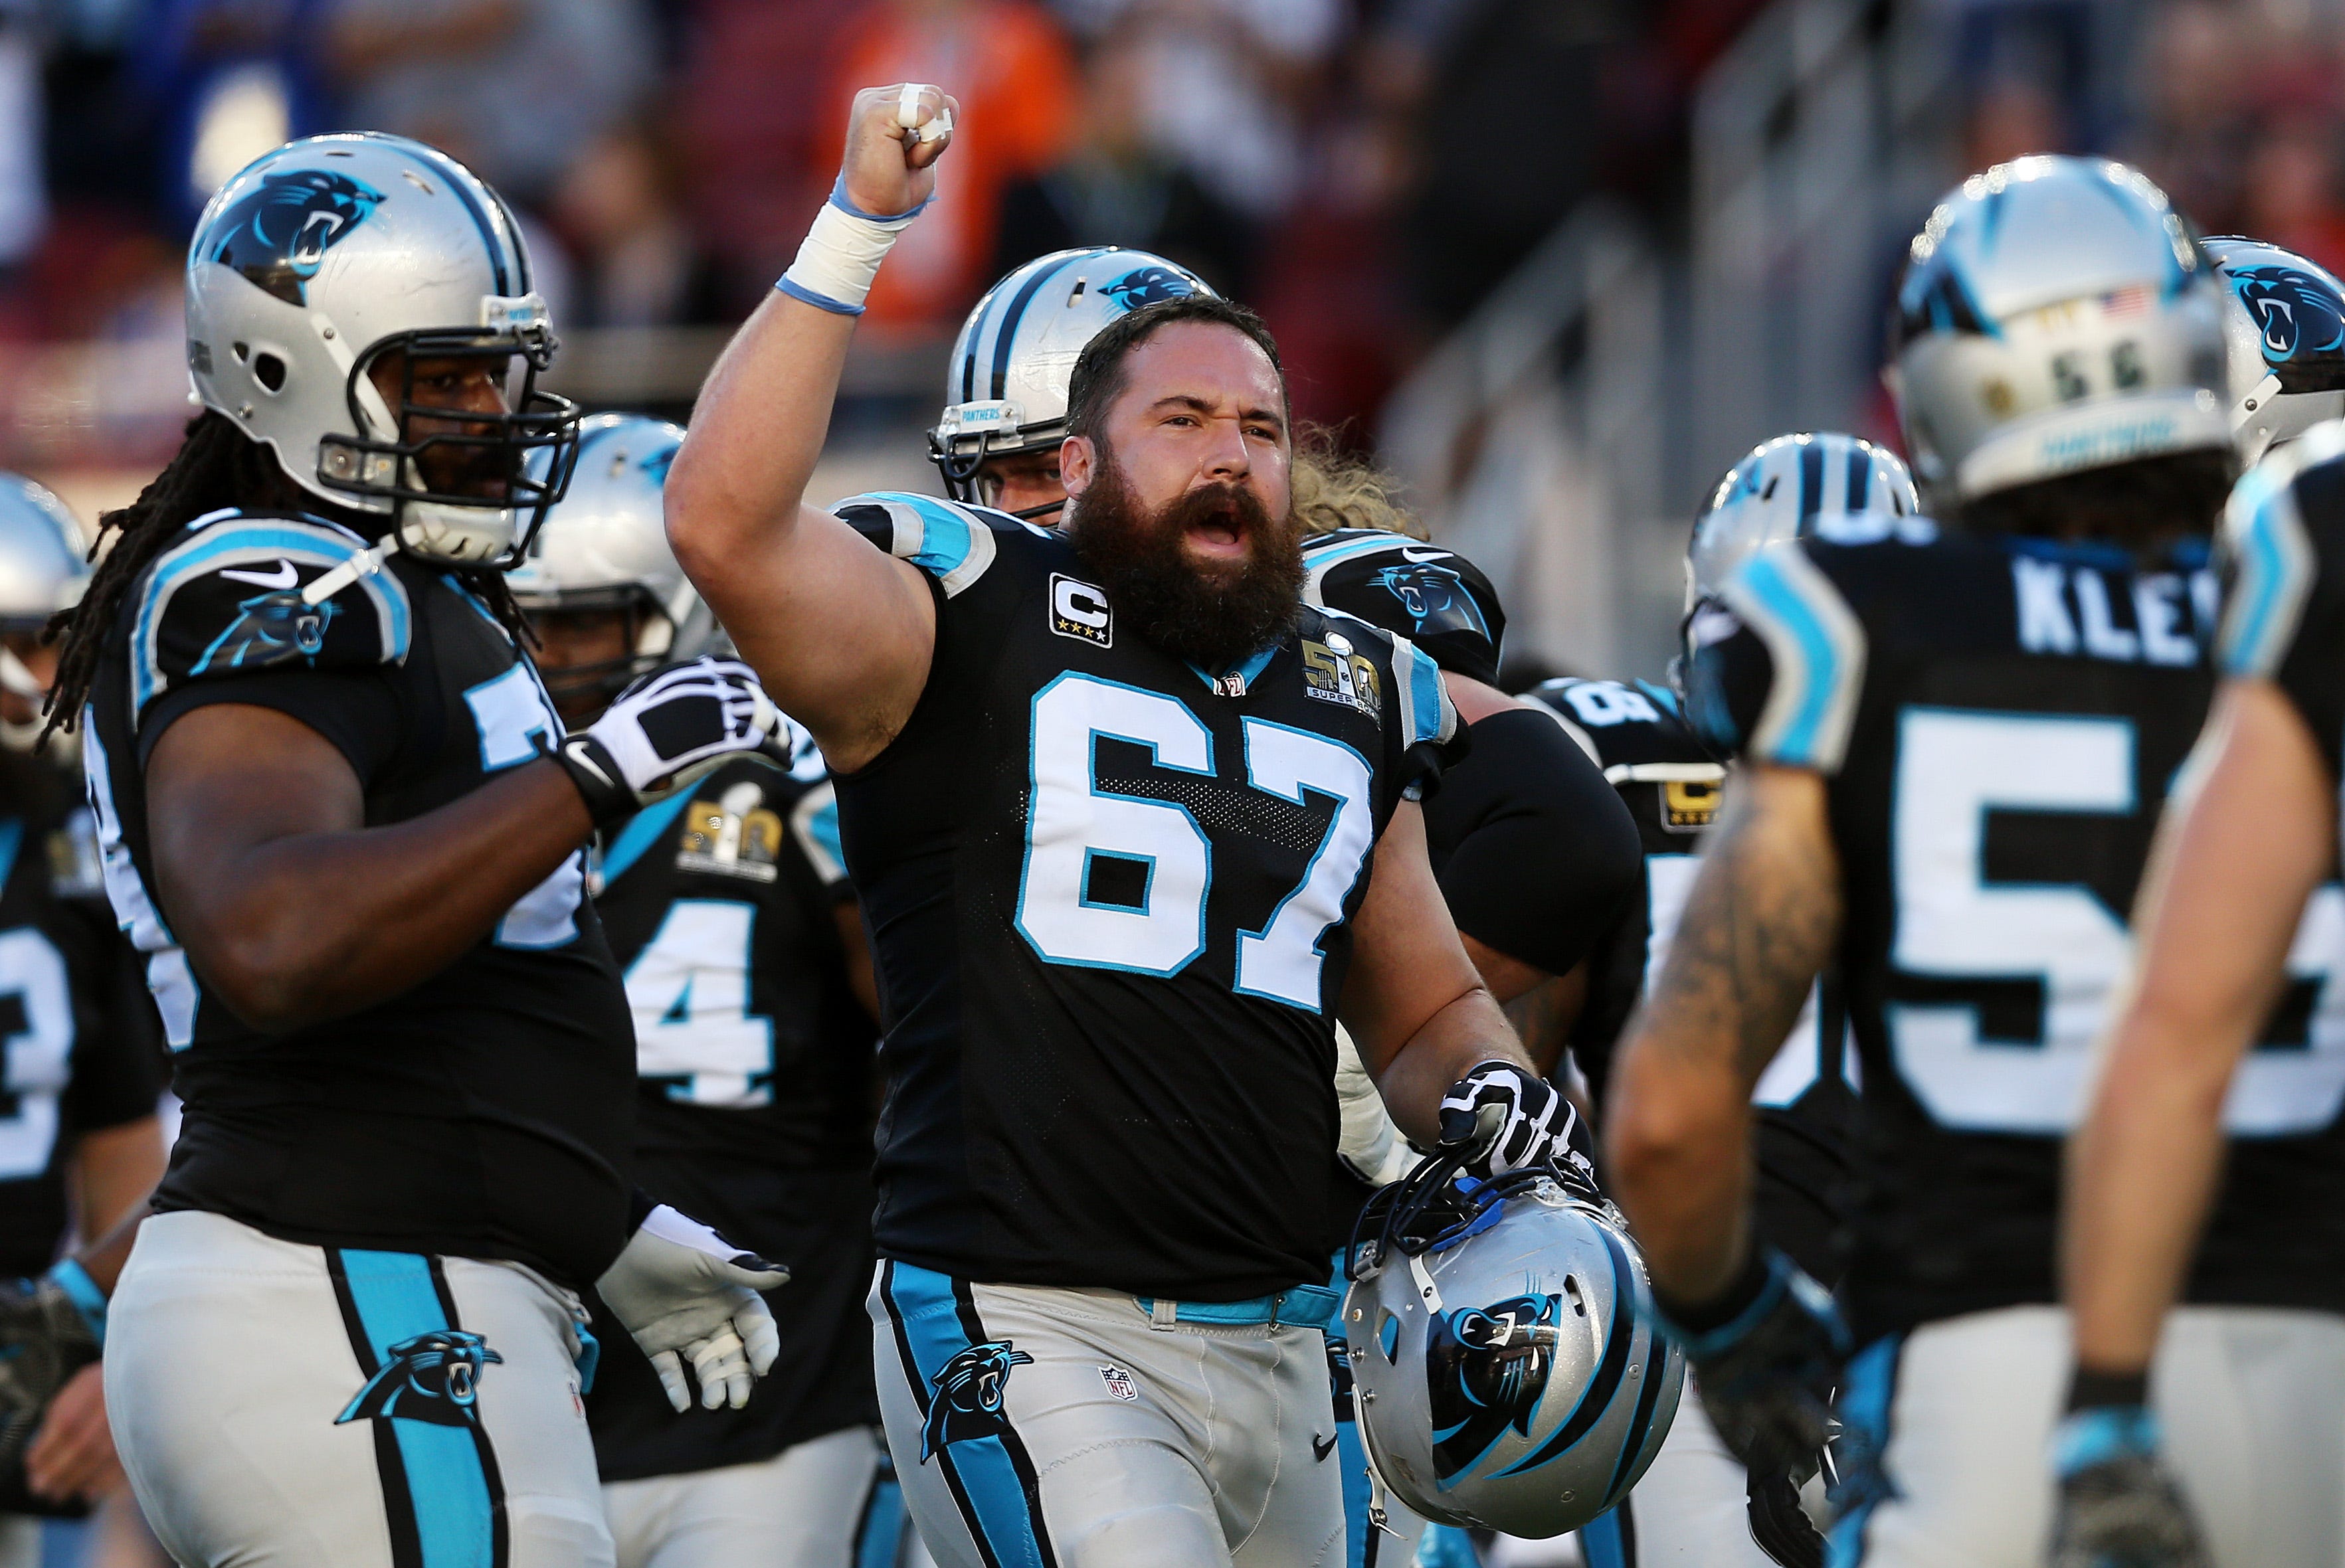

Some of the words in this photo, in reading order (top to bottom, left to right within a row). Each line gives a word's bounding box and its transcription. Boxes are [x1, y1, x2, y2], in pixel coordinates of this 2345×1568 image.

[963, 408, 1000, 422] PANTHERS
[1055, 580, 1108, 628] C
[1301, 639, 1381, 707] 50
[1312, 689, 1353, 706] SUPER
[1014, 669, 1374, 1015] 67
[623, 898, 776, 1108] 4
[1108, 1381, 1133, 1397] NFL
